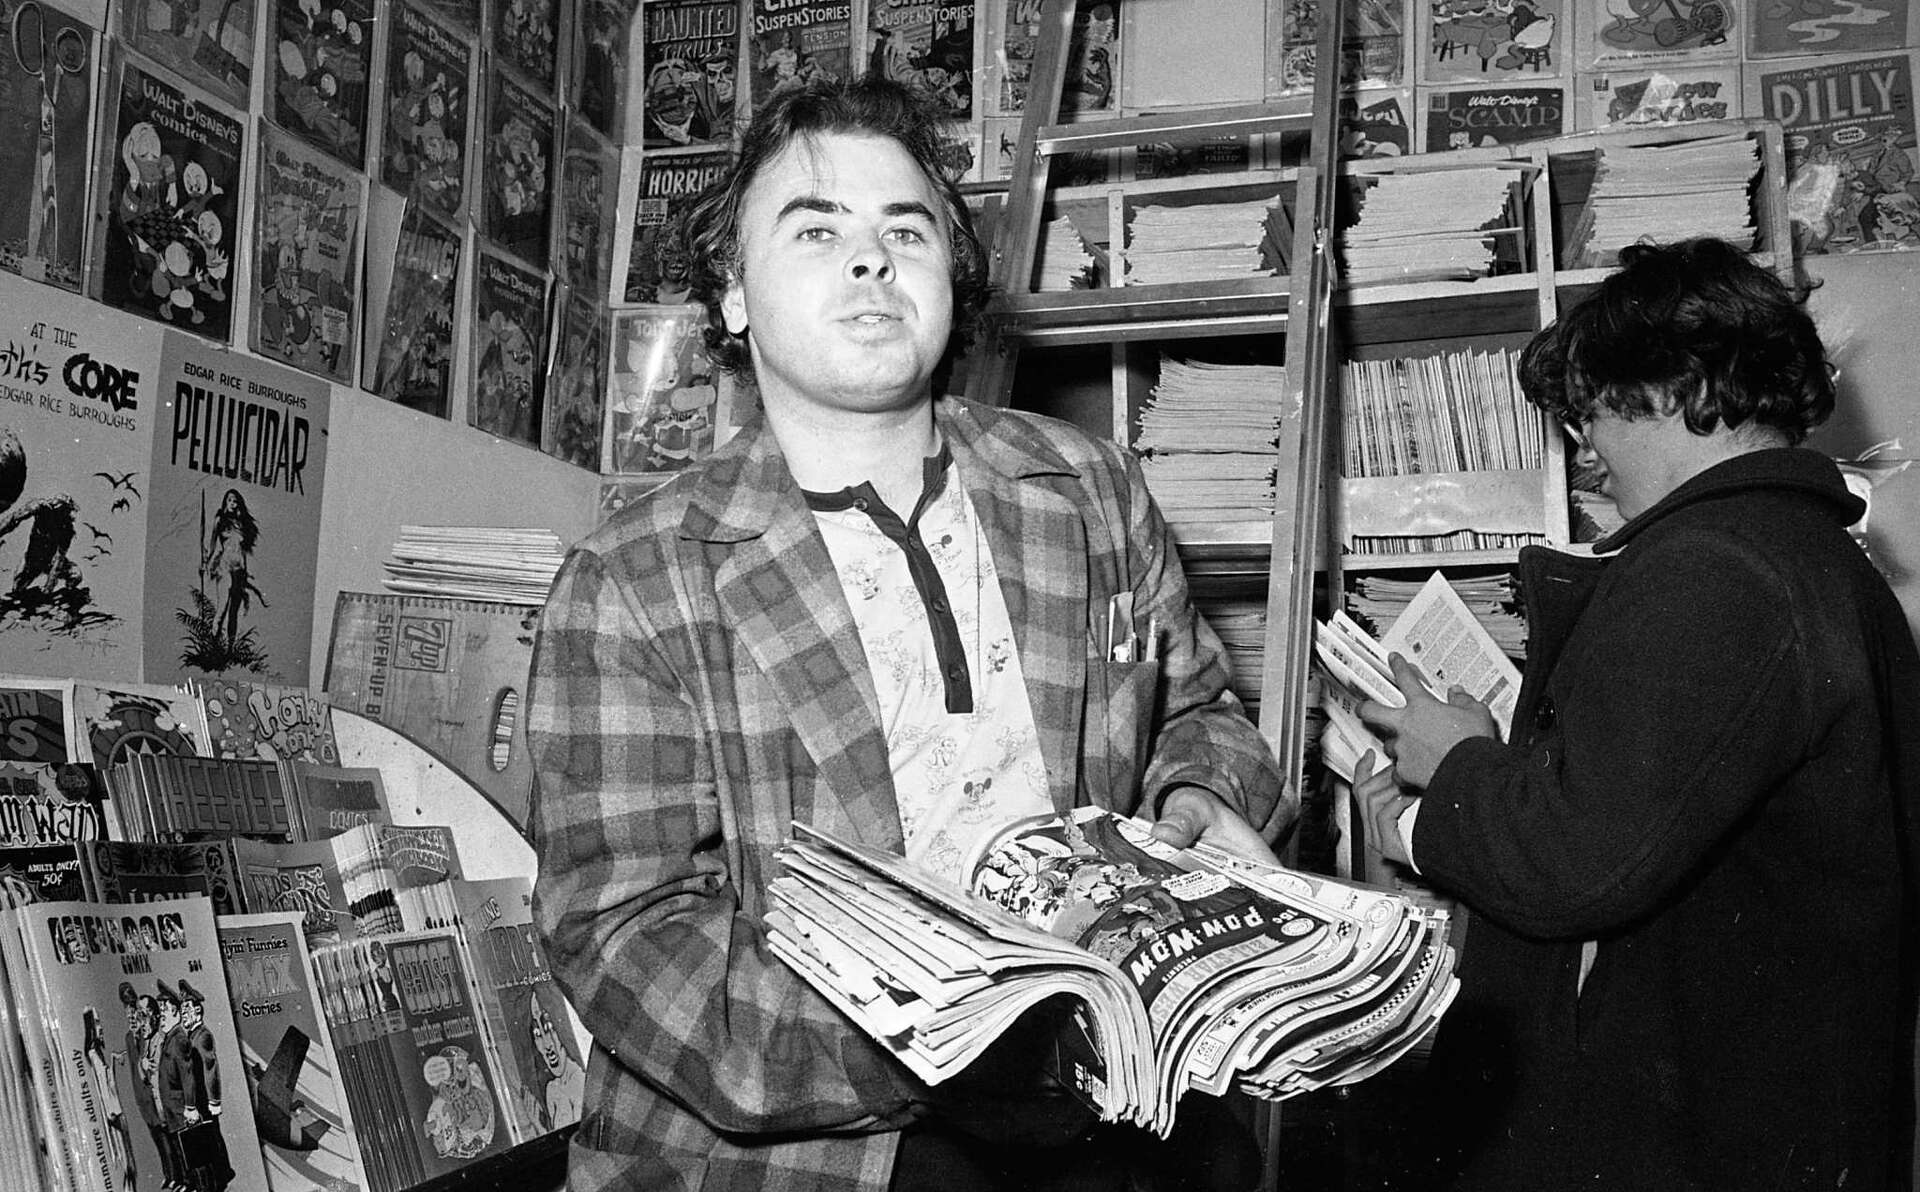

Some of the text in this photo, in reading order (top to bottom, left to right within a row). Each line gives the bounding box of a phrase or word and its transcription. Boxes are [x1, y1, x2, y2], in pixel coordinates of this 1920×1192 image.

[651, 5, 737, 44] HAUNTED
[143, 79, 180, 113] WALT
[1771, 69, 1898, 126] DILLY
[1448, 106, 1561, 128] SCAMP
[30, 322, 79, 349] AT THE
[62, 353, 140, 412] CORE
[184, 362, 308, 410] EDGAR RICE BURROUGHS
[0, 384, 137, 431] EDGAR RICE BURROUGHS
[171, 381, 310, 497] PELLUCIDAR
[28, 862, 55, 874] ADULTS
[41, 873, 64, 888] 50¢
[248, 937, 289, 953] Funnies
[241, 1000, 283, 1019] Stories
[72, 1049, 86, 1077] only
[80, 1081, 98, 1123] adults
